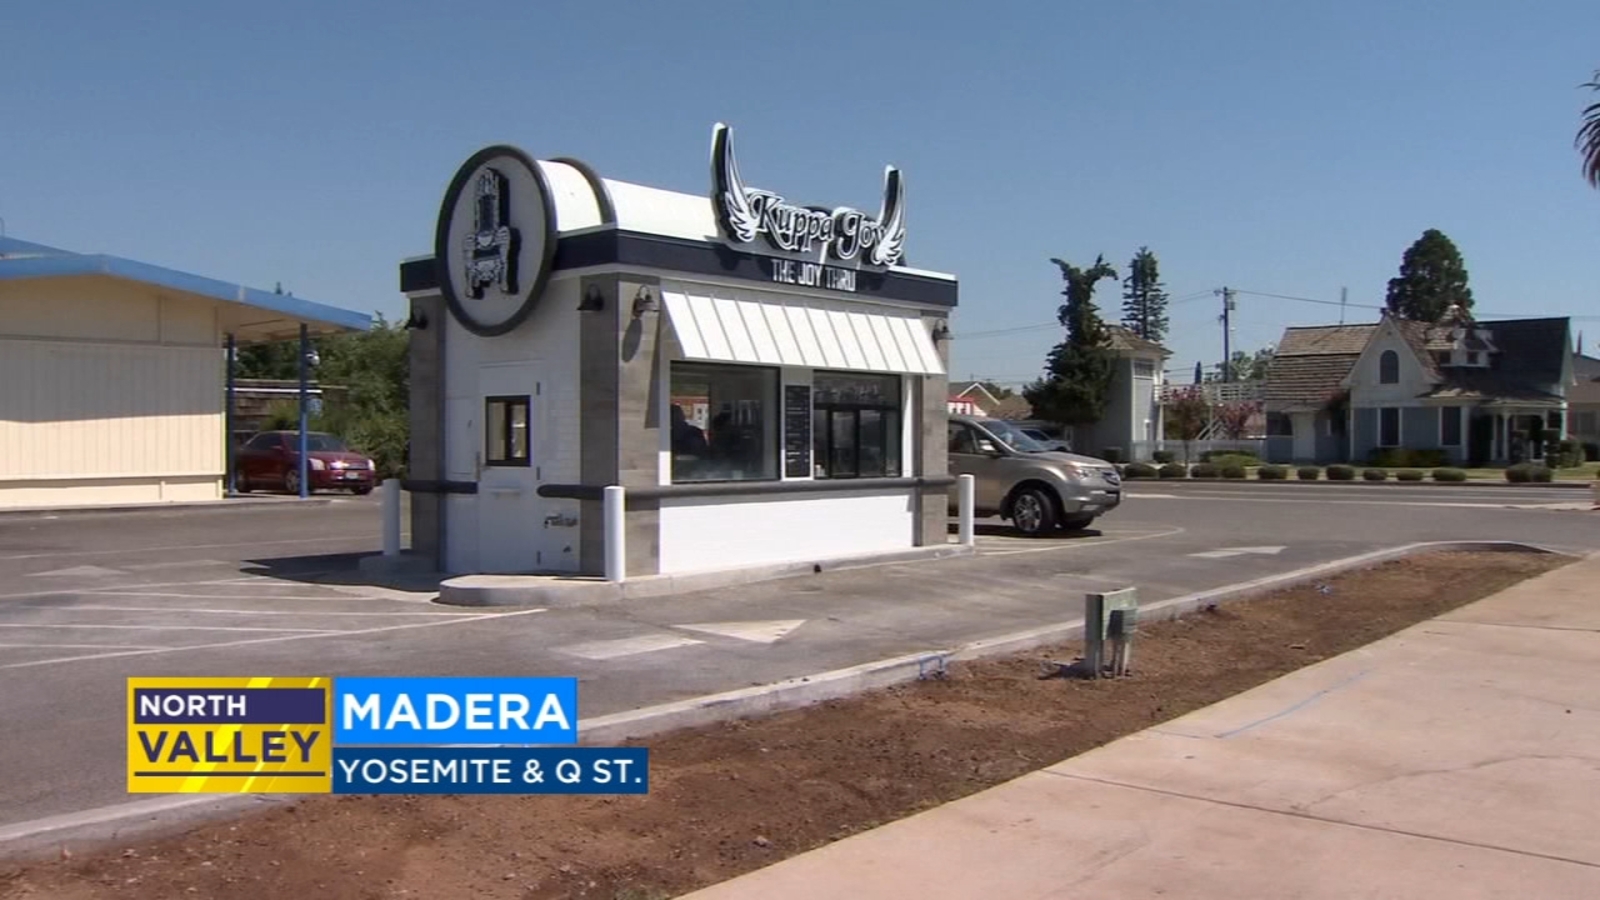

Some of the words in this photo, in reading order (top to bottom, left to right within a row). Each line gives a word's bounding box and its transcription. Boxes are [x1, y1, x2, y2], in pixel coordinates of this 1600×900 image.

[750, 192, 835, 252] Kuppa
[771, 259, 796, 282] THE
[798, 263, 822, 287] JOY
[826, 267, 856, 291] THRU
